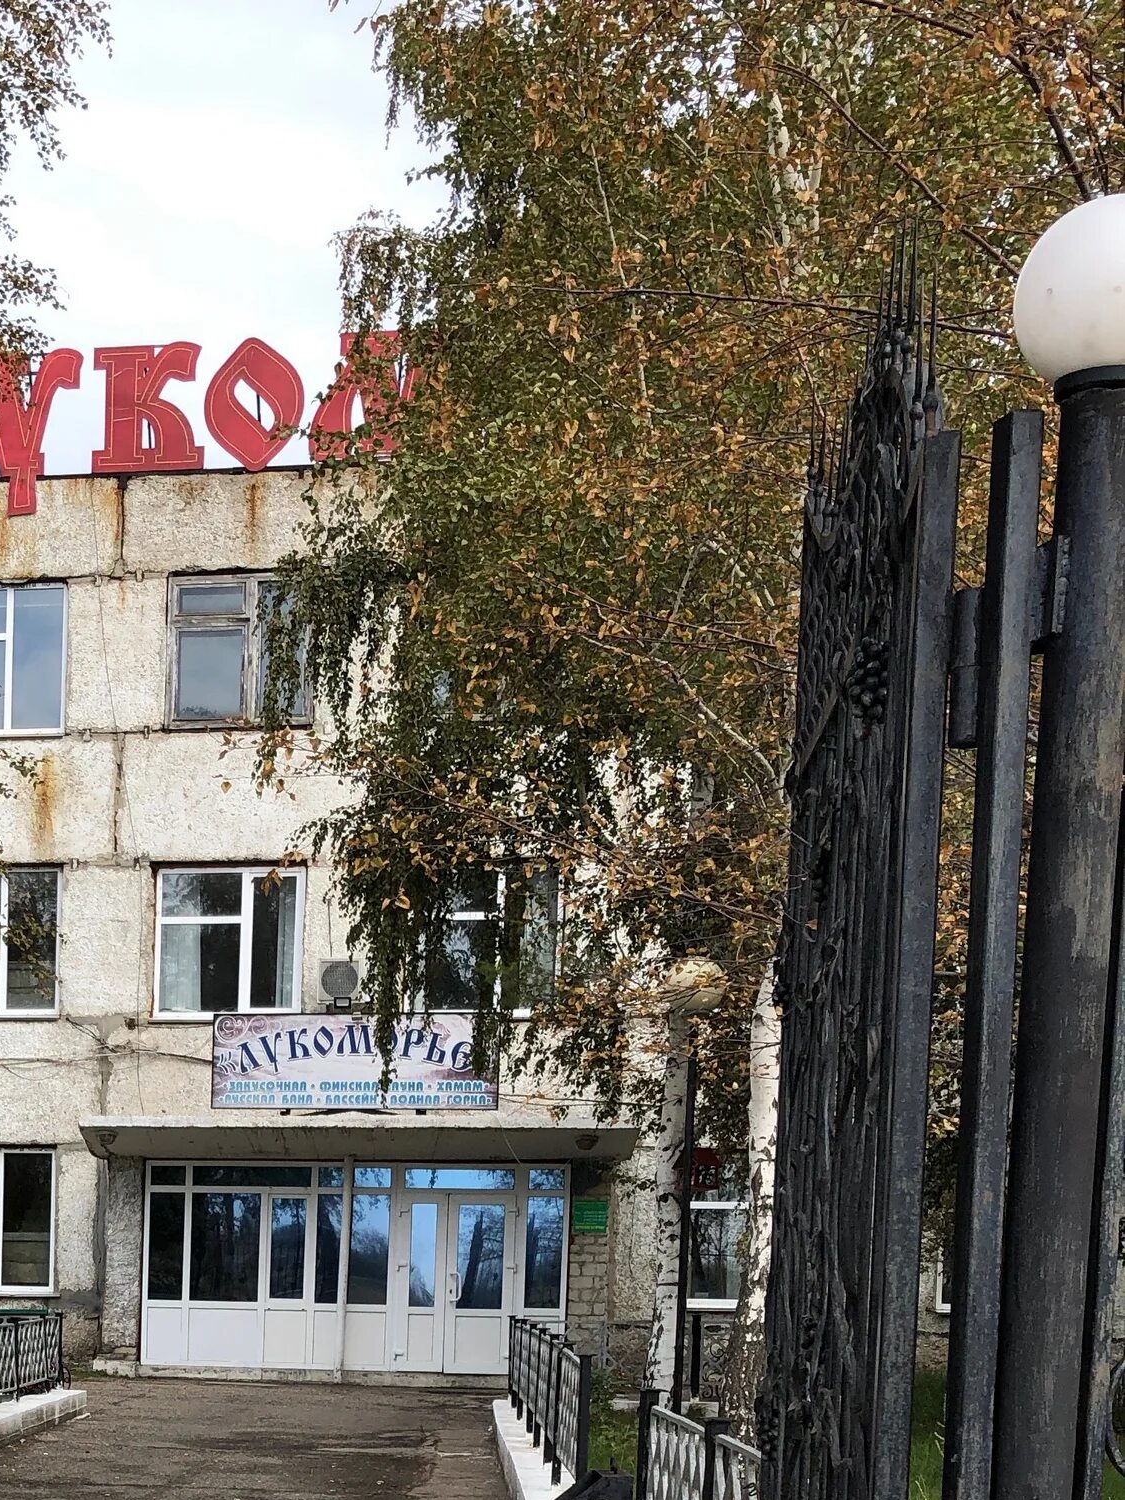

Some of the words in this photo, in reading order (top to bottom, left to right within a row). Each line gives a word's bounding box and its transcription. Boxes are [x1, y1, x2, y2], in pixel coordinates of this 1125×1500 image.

[228, 1081, 307, 1092] ЗАКУСОЧНАЯ
[319, 1081, 379, 1092] ФИНСКАЯ
[383, 1081, 424, 1092] АУНА
[437, 1081, 482, 1092] ХАМАМ
[224, 1094, 275, 1105] РУССКАЯ
[281, 1094, 313, 1105] БАНЯ
[325, 1093, 377, 1105] БАССЕЙН
[390, 1094, 440, 1105] ВОДНАЯ
[447, 1094, 486, 1105] ГОРКА
